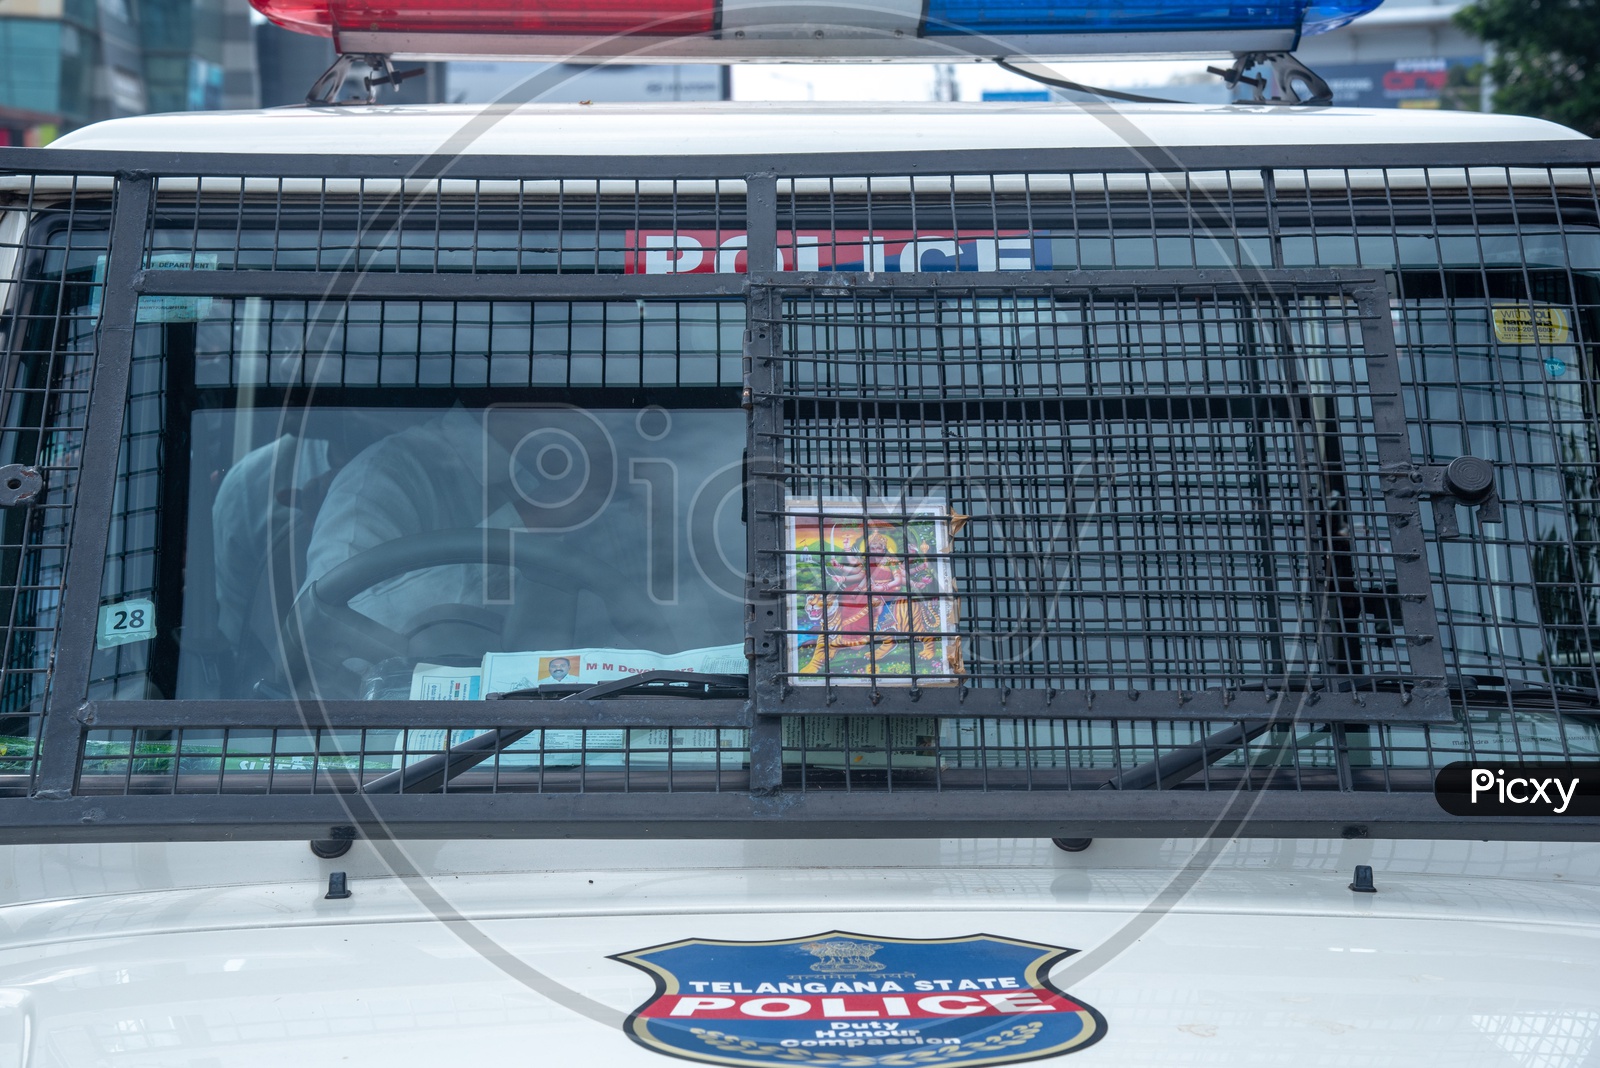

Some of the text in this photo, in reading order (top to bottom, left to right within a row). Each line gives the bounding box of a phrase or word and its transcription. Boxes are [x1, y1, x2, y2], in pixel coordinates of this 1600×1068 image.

[645, 235, 1031, 273] POLICE
[113, 609, 145, 630] 28
[586, 662, 598, 671] M
[602, 662, 614, 671] M
[688, 976, 1020, 994] TELANGANA STATE
[669, 992, 1057, 1018] POLICE
[830, 1021, 900, 1031] Duty
[815, 1029, 920, 1038] Honour
[779, 1037, 961, 1048] Compassion
